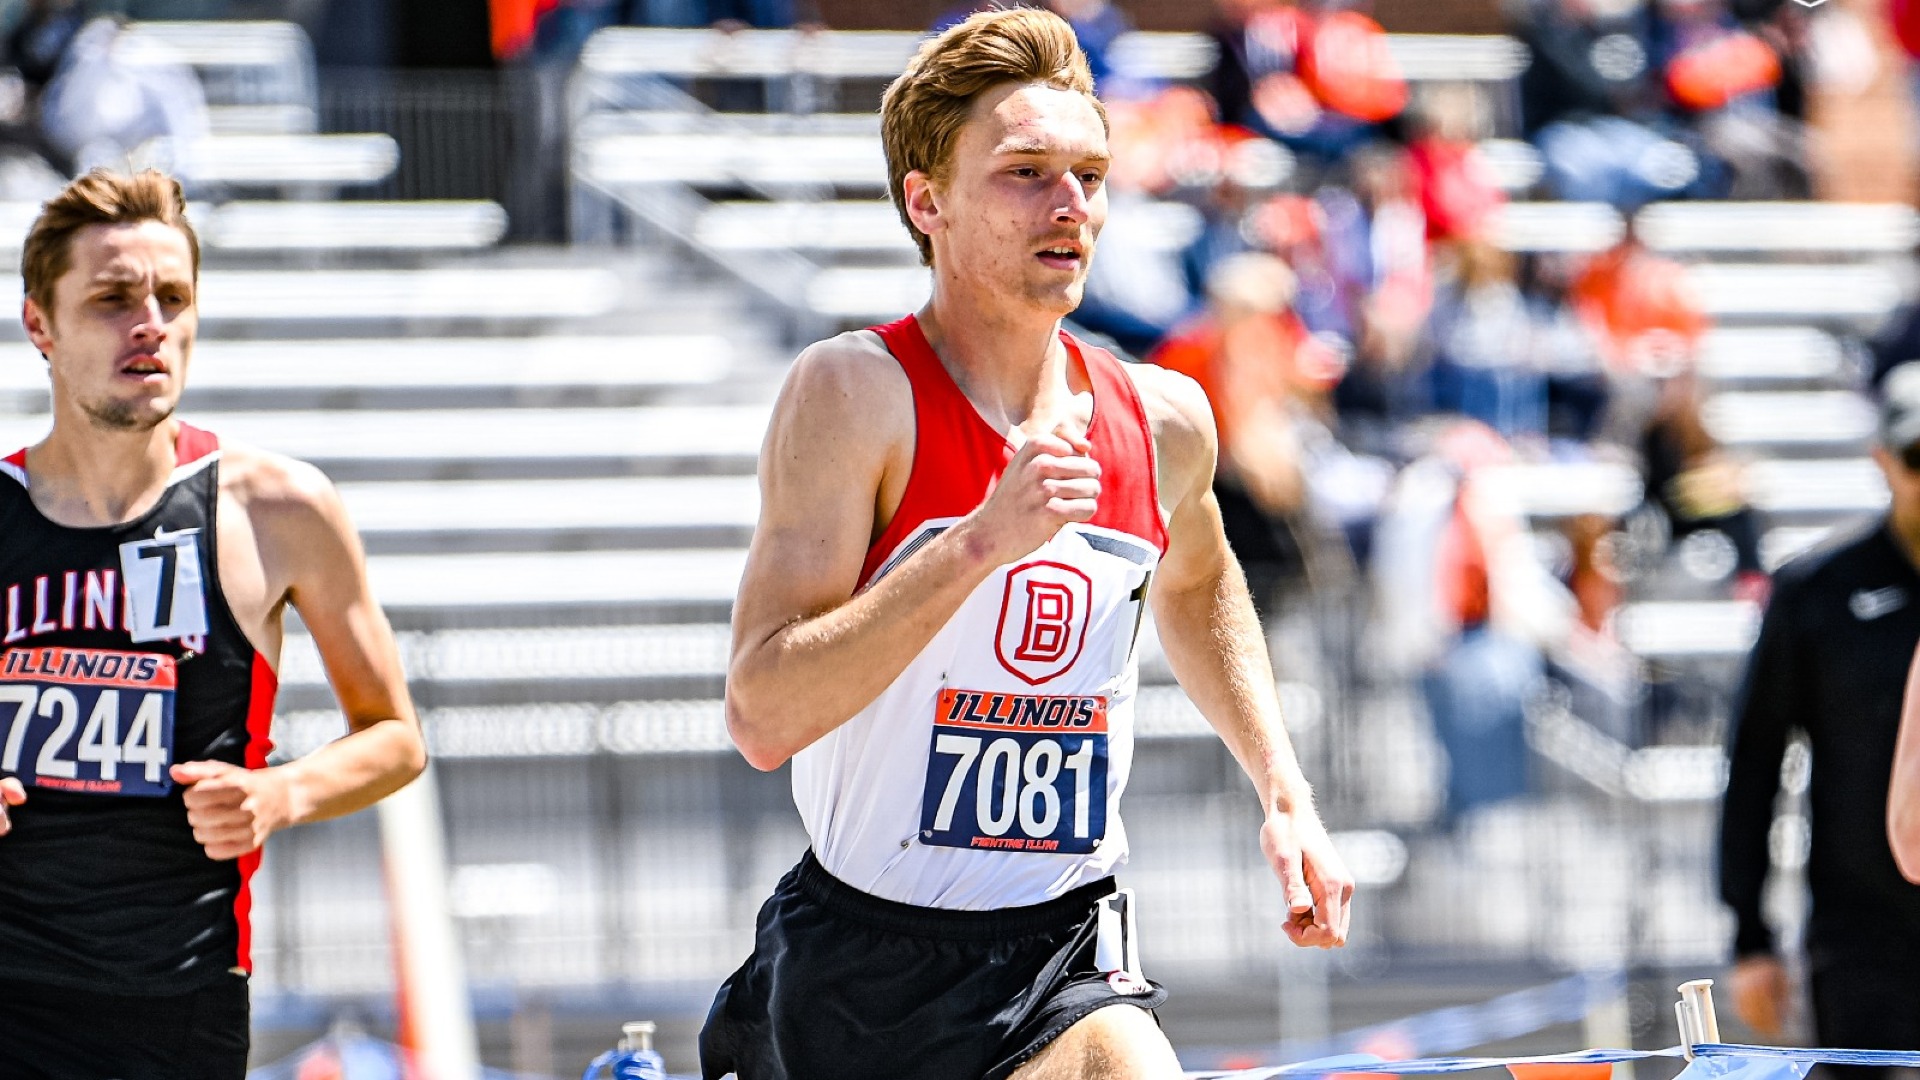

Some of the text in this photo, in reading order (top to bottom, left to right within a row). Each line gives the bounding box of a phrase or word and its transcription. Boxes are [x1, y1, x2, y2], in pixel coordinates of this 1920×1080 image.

[138, 545, 177, 629] 7
[1014, 580, 1073, 662] B
[4, 651, 158, 681] ILLINOIS
[0, 684, 168, 782] 7244
[948, 693, 1095, 728] ILLINOIS
[933, 734, 1094, 839] 7081
